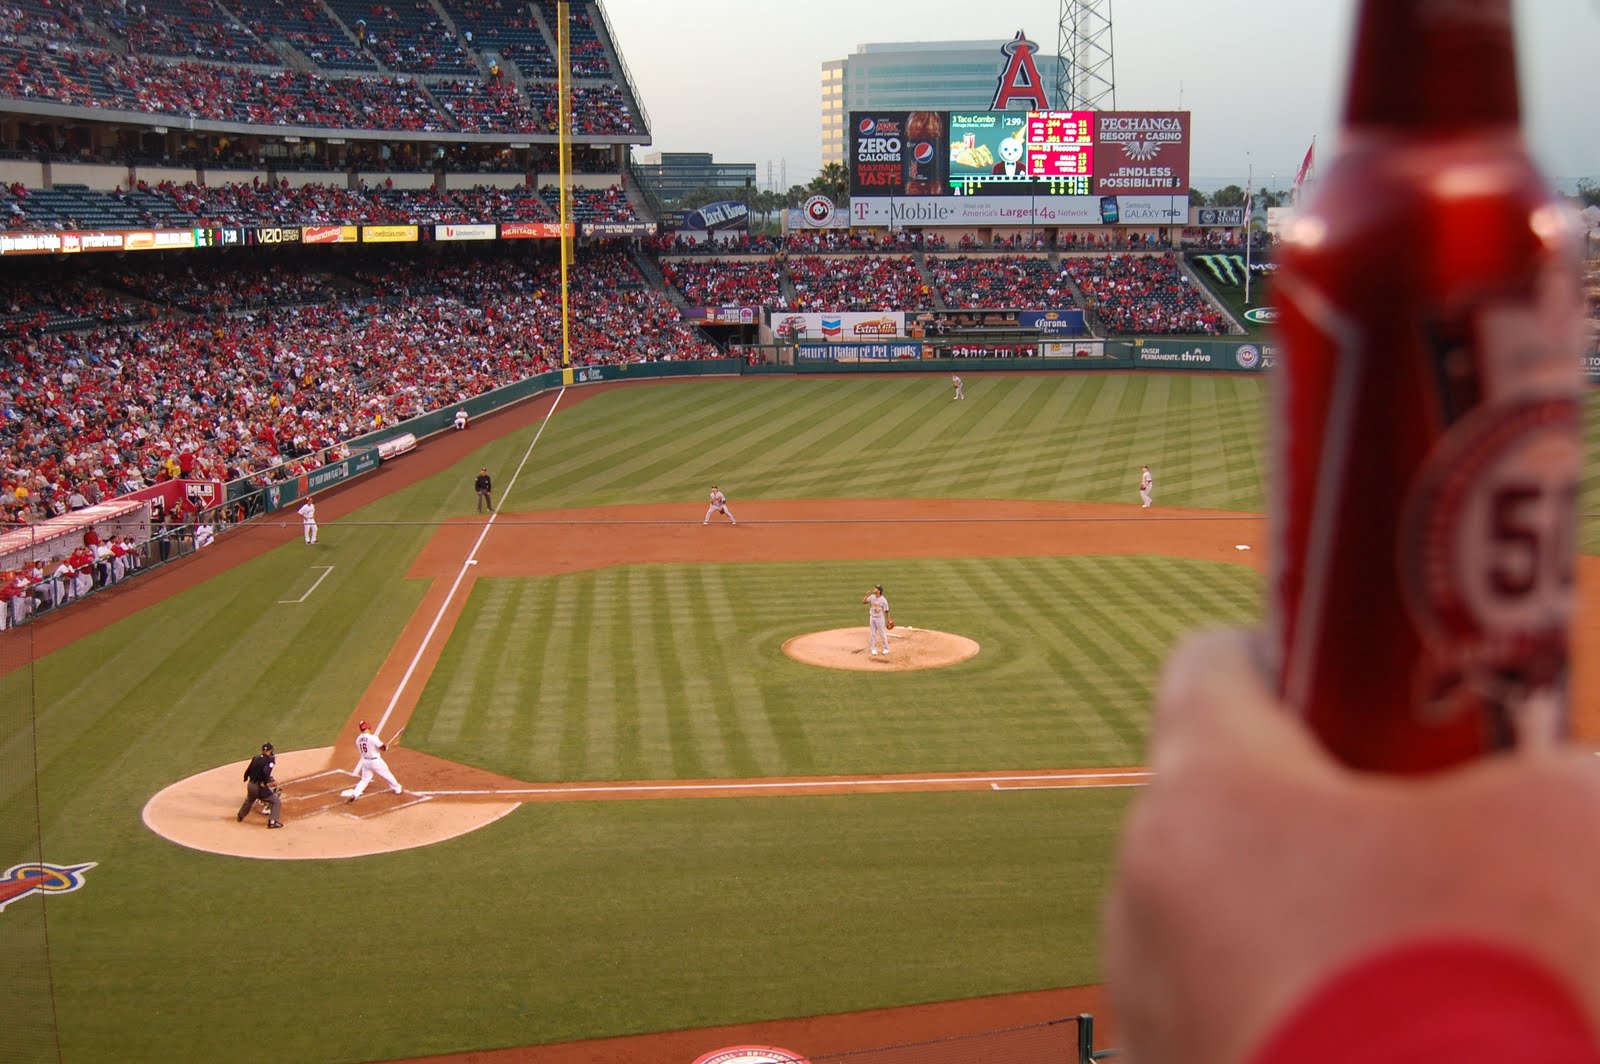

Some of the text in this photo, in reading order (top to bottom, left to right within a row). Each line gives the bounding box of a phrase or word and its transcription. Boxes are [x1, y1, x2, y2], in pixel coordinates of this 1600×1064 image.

[991, 28, 1051, 111] A
[973, 115, 995, 123] Combo
[1100, 118, 1181, 130] PECHANGA
[858, 138, 901, 153] ZERO
[858, 153, 901, 162] CALORIES
[858, 163, 902, 172] MAXIMUM
[858, 172, 901, 185] TASTE
[698, 203, 748, 226] Yard House
[962, 206, 1088, 219] America's Largest 4G Network
[1124, 209, 1181, 218] GALAXY Tab
[257, 228, 282, 243] VIZIO
[502, 228, 538, 236] HERITAGE
[1035, 319, 1067, 327] Corona
[834, 346, 870, 358] Balance
[872, 346, 887, 358] Pet
[1181, 351, 1211, 362] thrive
[187, 484, 213, 494] MLB
